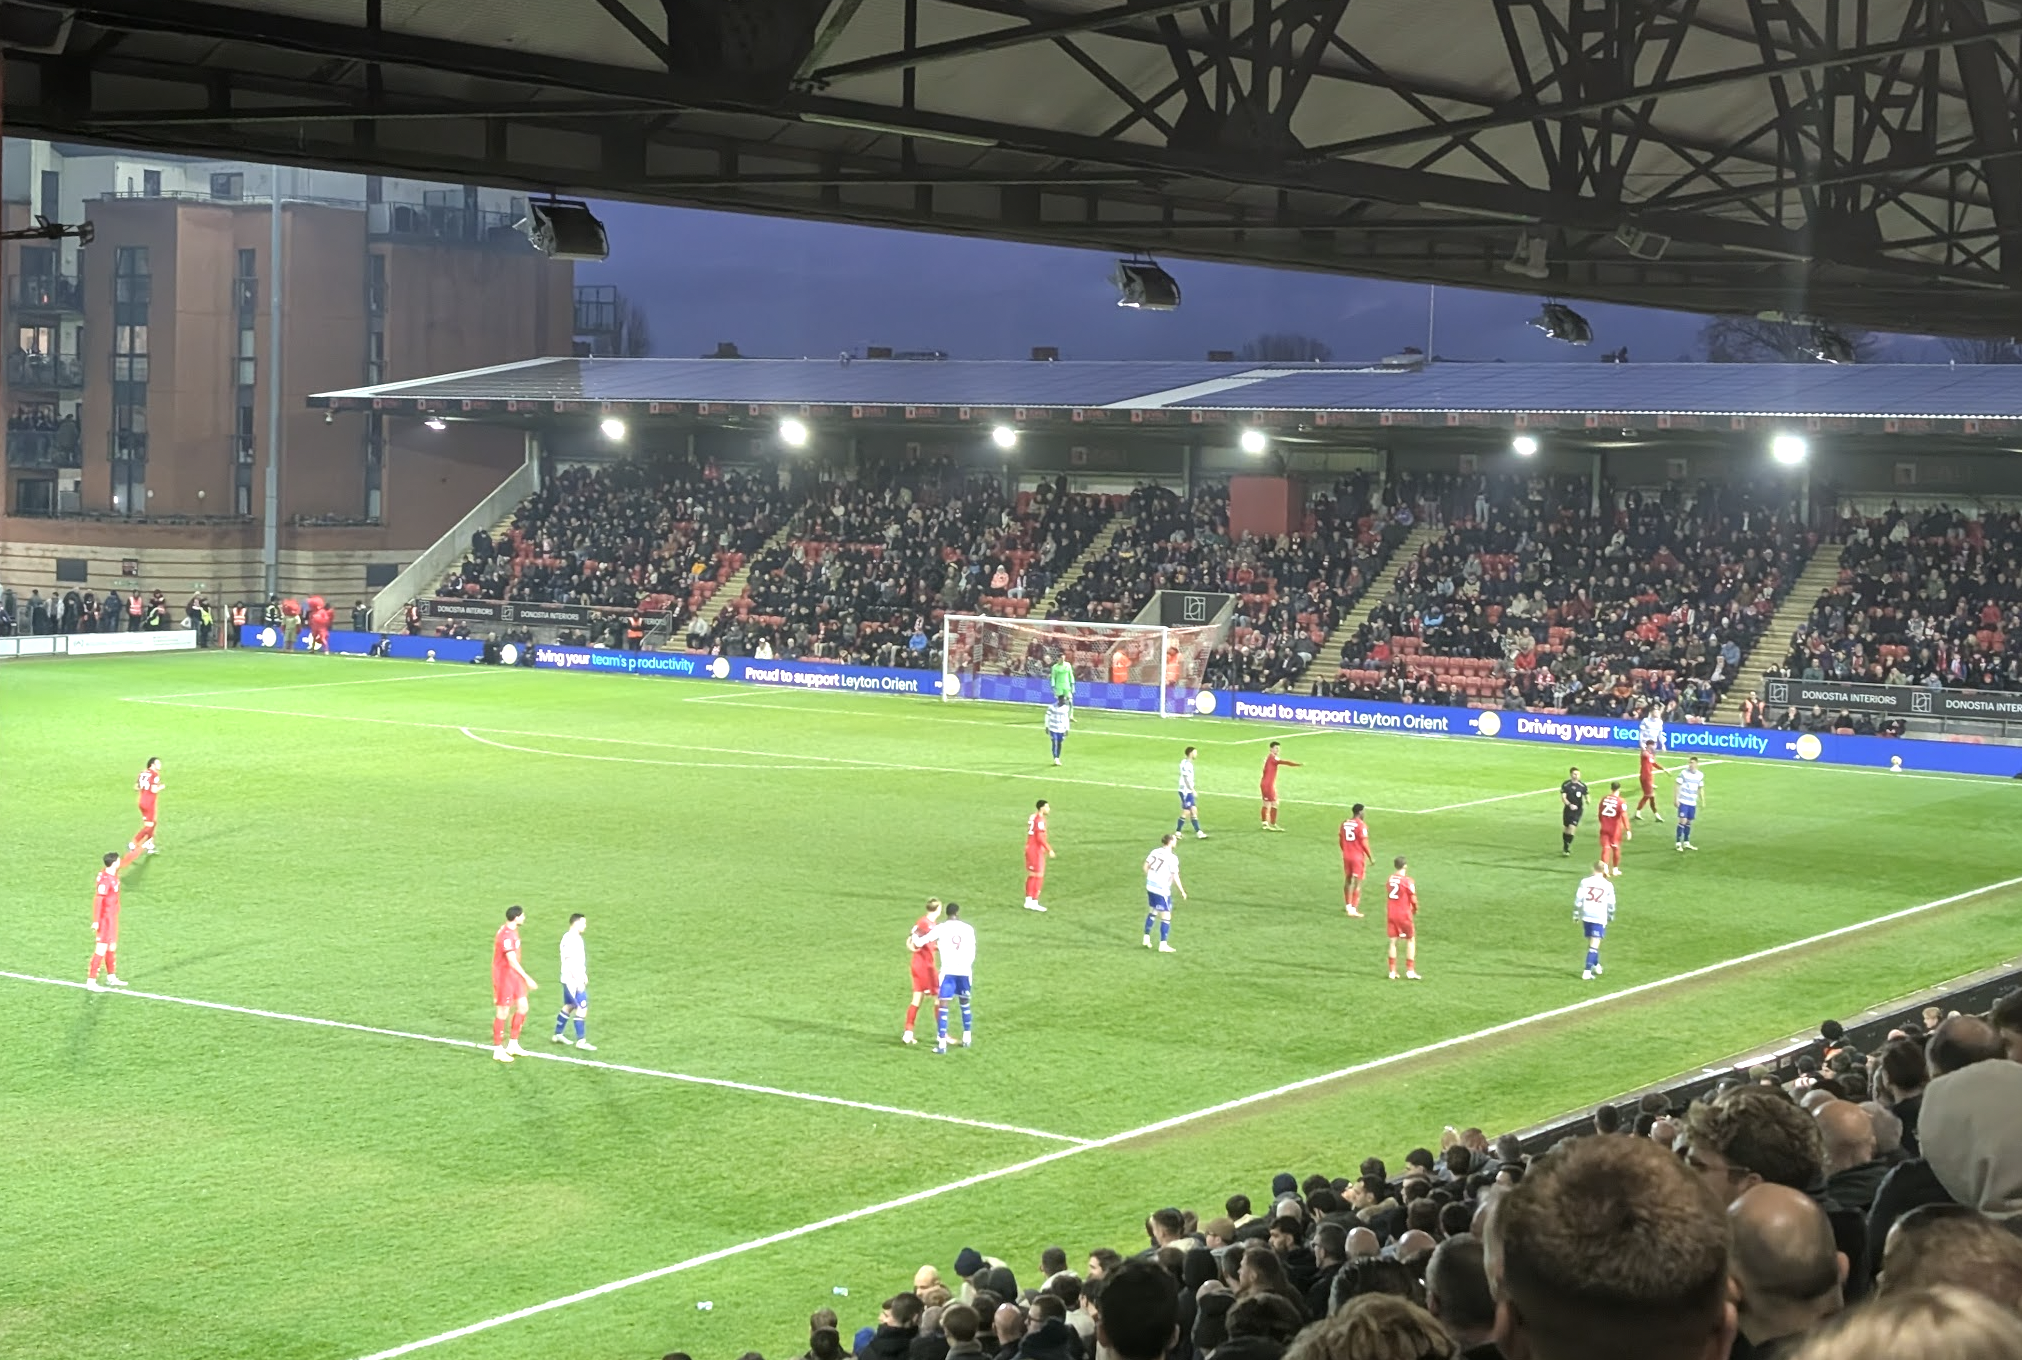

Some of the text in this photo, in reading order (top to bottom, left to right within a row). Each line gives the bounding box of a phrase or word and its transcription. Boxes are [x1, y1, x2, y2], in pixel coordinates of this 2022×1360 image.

[550, 612, 579, 621] INTERIORS
[566, 653, 590, 668] your
[591, 653, 626, 668] team's
[745, 667, 779, 683] Proud
[780, 670, 794, 683] to
[794, 672, 839, 688] support
[841, 675, 880, 690] Leyton
[881, 677, 918, 692] Orient
[1802, 690, 1897, 705] DONOSTIA INTERIORS
[1945, 699, 1995, 711] DONOSTIA
[1236, 701, 1448, 731] Proud to support Leyton Orient
[1517, 718, 1571, 740] Driving
[1574, 725, 1610, 742] your
[1670, 730, 1769, 754] productivity
[1601, 802, 1617, 817] 25
[1148, 855, 1165, 872] 27
[1389, 883, 1400, 900] 2
[1585, 886, 1605, 903] 32
[951, 935, 962, 951] 9
